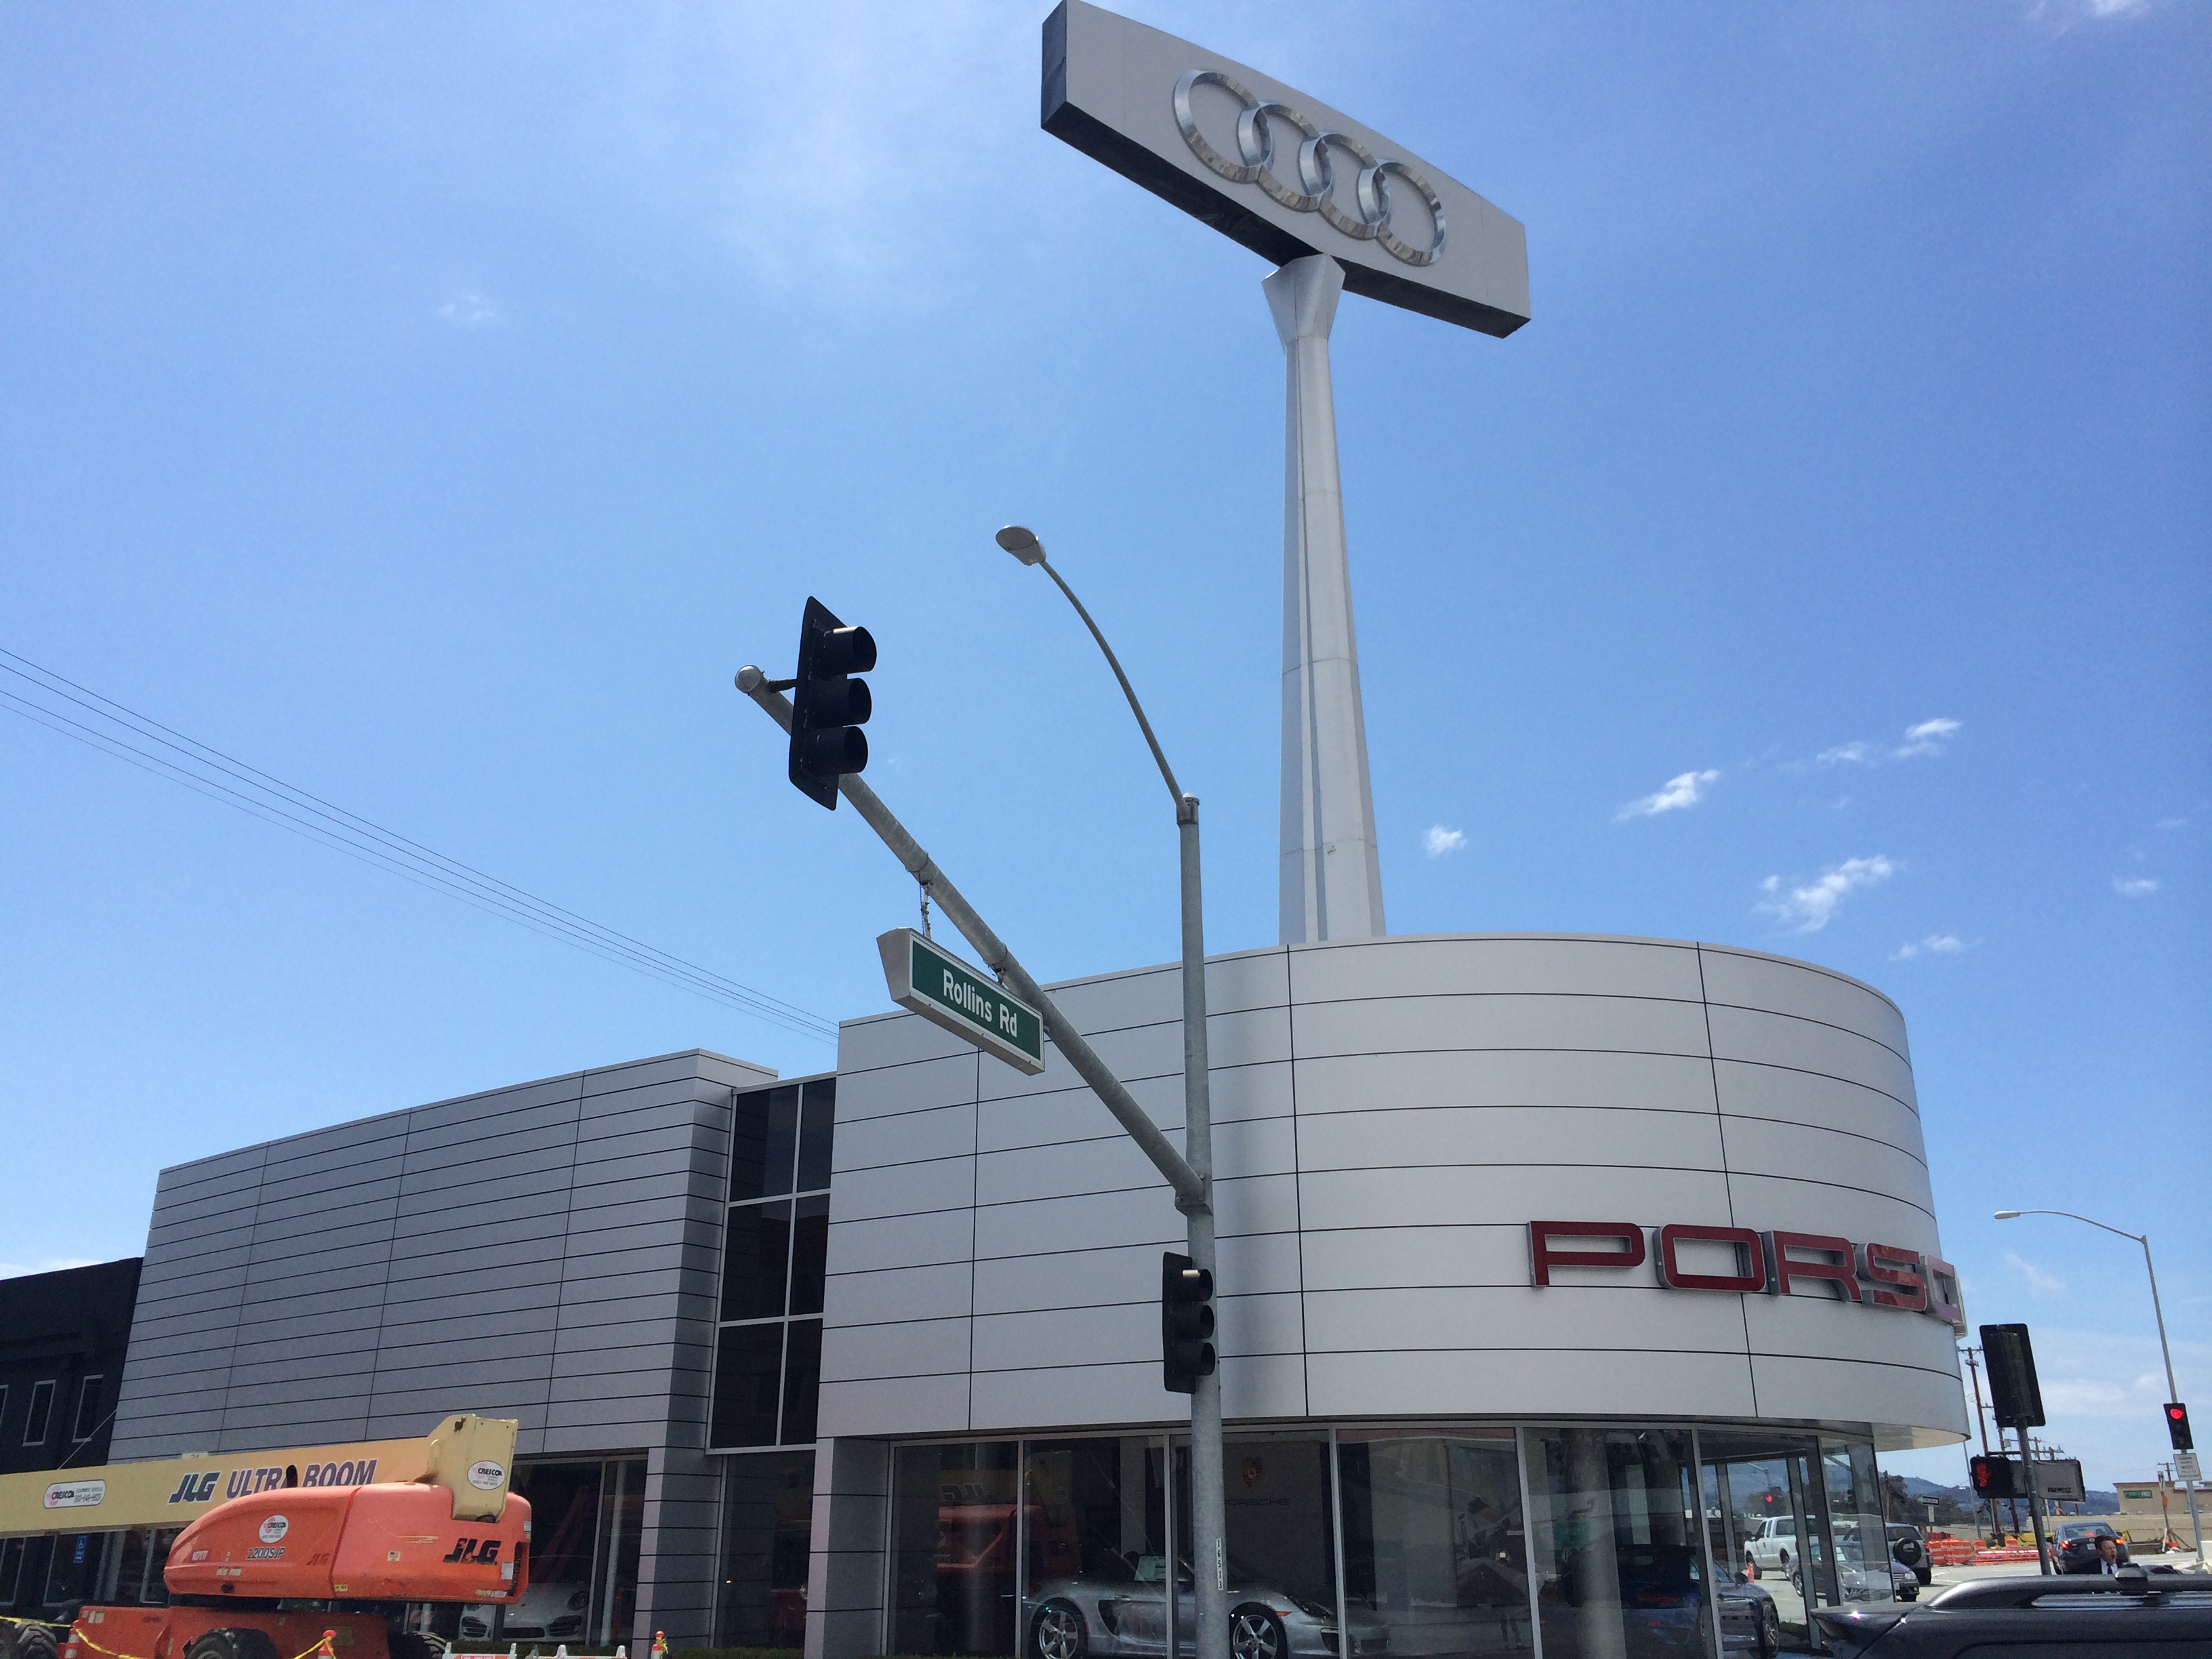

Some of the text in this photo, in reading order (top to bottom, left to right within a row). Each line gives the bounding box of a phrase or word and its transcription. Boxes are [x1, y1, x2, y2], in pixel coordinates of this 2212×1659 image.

[943, 968, 1017, 1038] Rollins Rd
[168, 1458, 378, 1504] JLG ULTR BOOM
[443, 1538, 501, 1565] JLG
